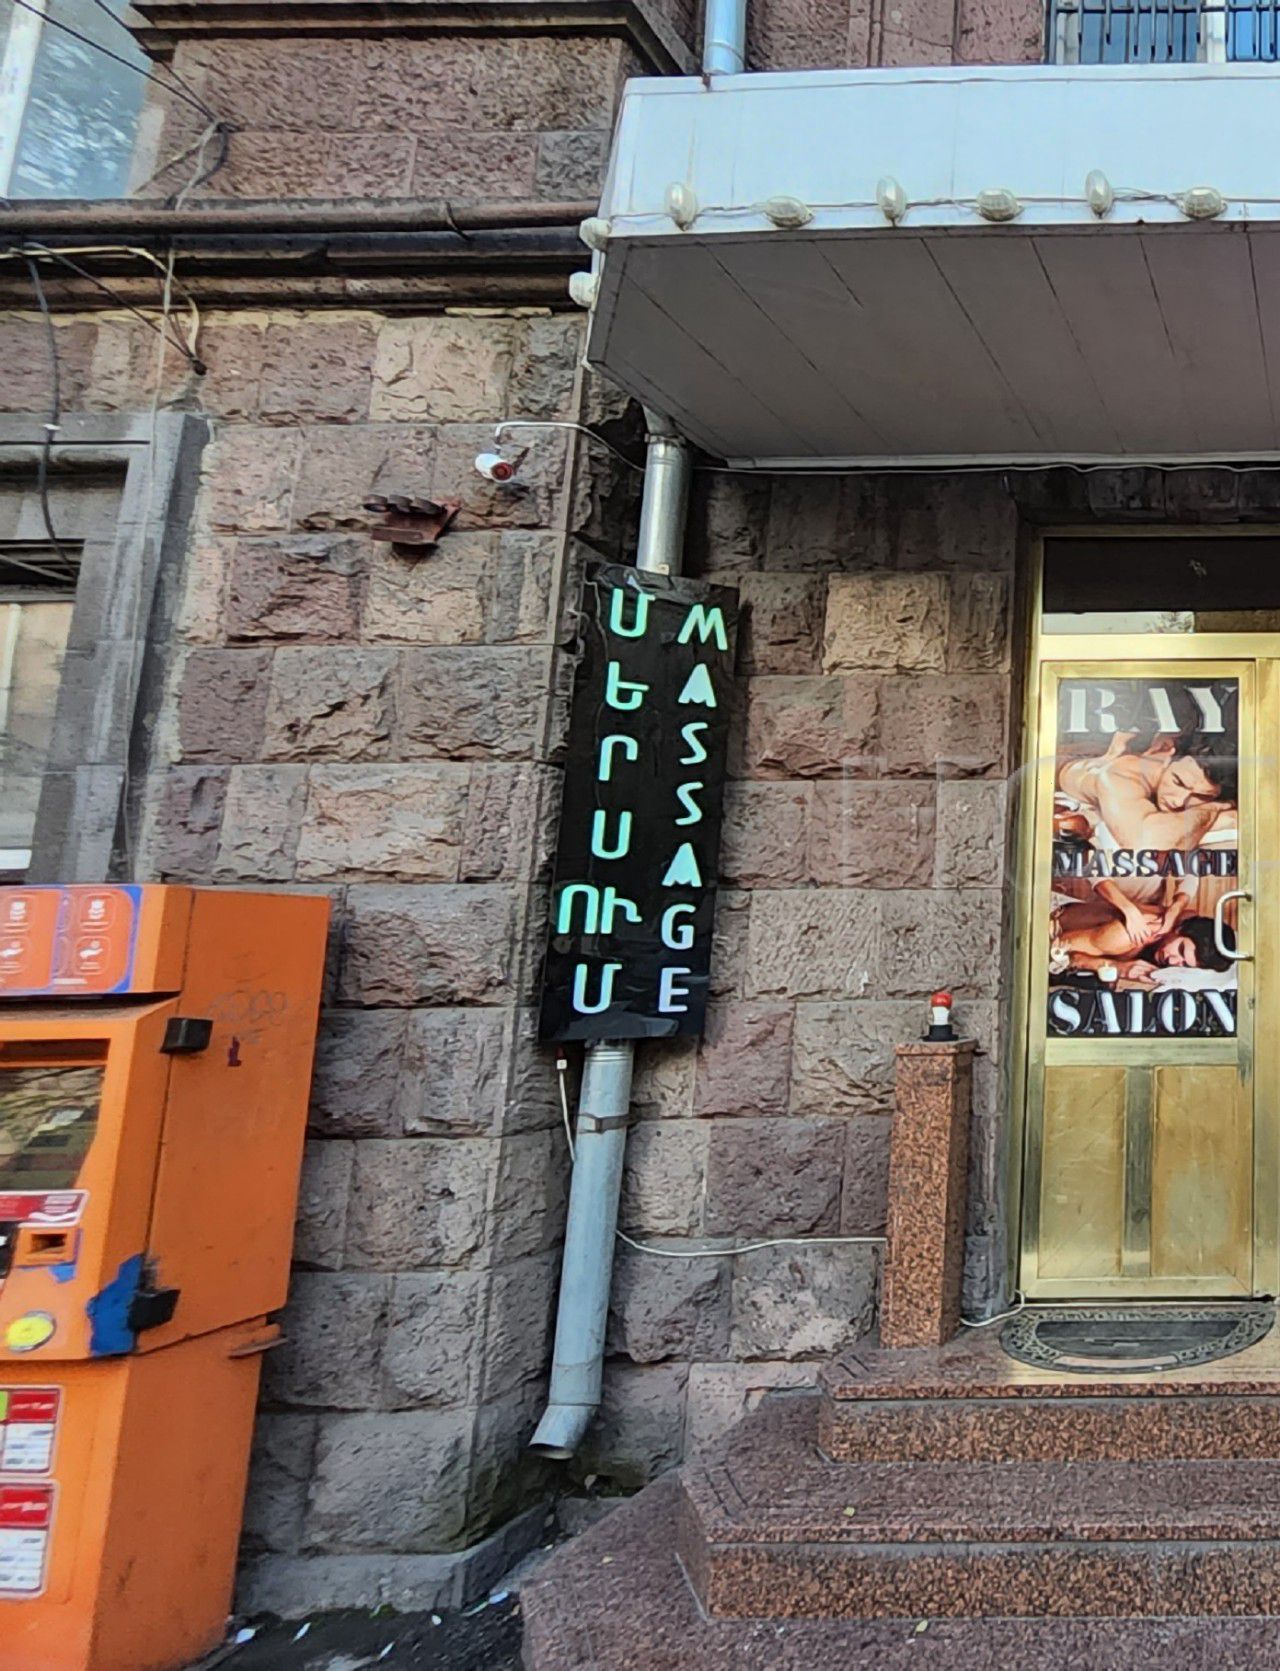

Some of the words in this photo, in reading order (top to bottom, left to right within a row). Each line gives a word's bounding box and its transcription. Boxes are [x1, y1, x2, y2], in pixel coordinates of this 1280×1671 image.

[1064, 685, 1238, 734] RAY
[658, 604, 728, 1013] MASSAGE
[1053, 848, 1238, 878] MASSAGE
[1048, 988, 1236, 1035] SALON
